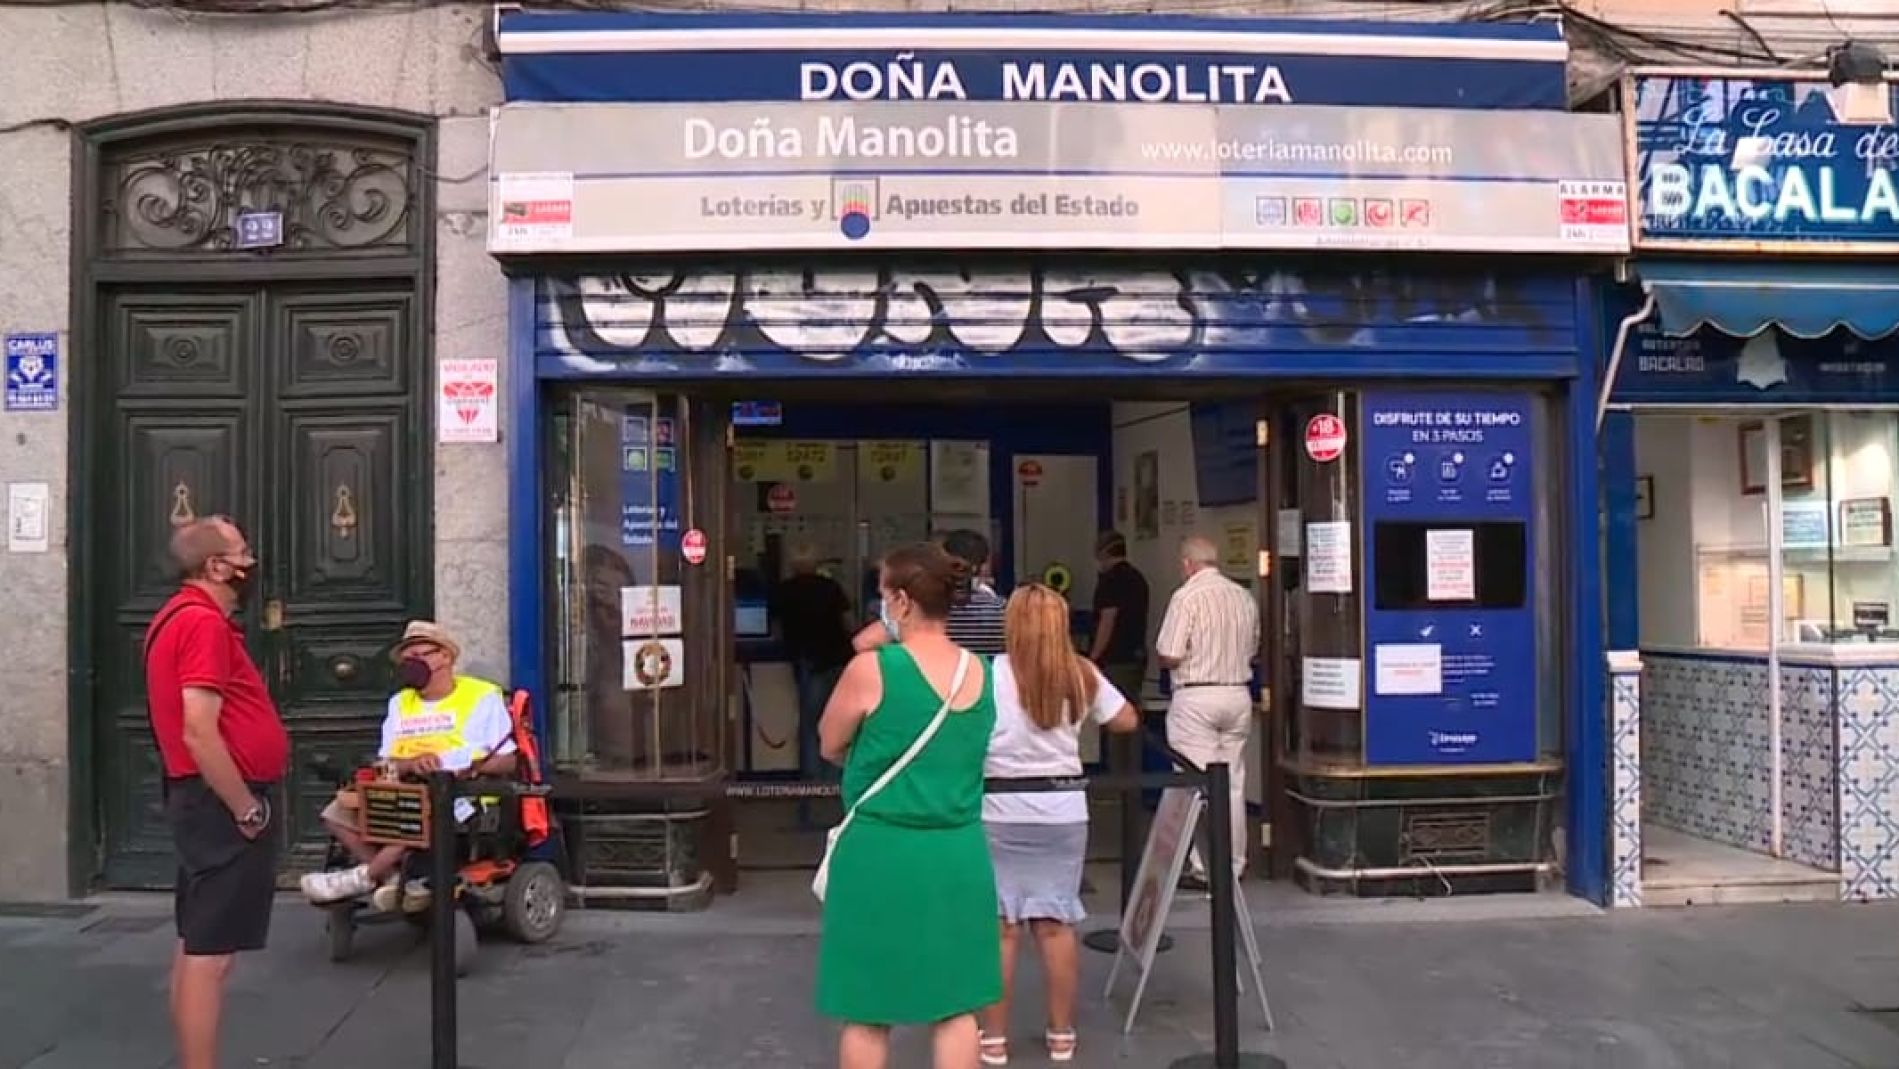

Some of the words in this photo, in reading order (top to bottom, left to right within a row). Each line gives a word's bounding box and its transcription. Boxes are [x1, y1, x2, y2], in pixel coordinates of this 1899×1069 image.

[801, 51, 966, 100] DOÑA
[1002, 62, 1292, 103] MANOLITA
[684, 117, 802, 158] Doña
[815, 114, 1018, 157] Manolita
[1674, 104, 1729, 156] La
[1743, 107, 1837, 158] Casa
[1141, 137, 1453, 163] www.loteriamanolita.com
[701, 193, 803, 217] Loterías
[811, 200, 825, 221] y
[887, 192, 1002, 221] Apuestas
[1011, 192, 1047, 216] del
[1055, 194, 1139, 217] Estado
[1373, 412, 1433, 425] DISFRUTE
[1436, 412, 1452, 425] DE
[1455, 412, 1472, 425] SU
[1475, 412, 1521, 425] TIEMPO
[1412, 430, 1430, 442] EN
